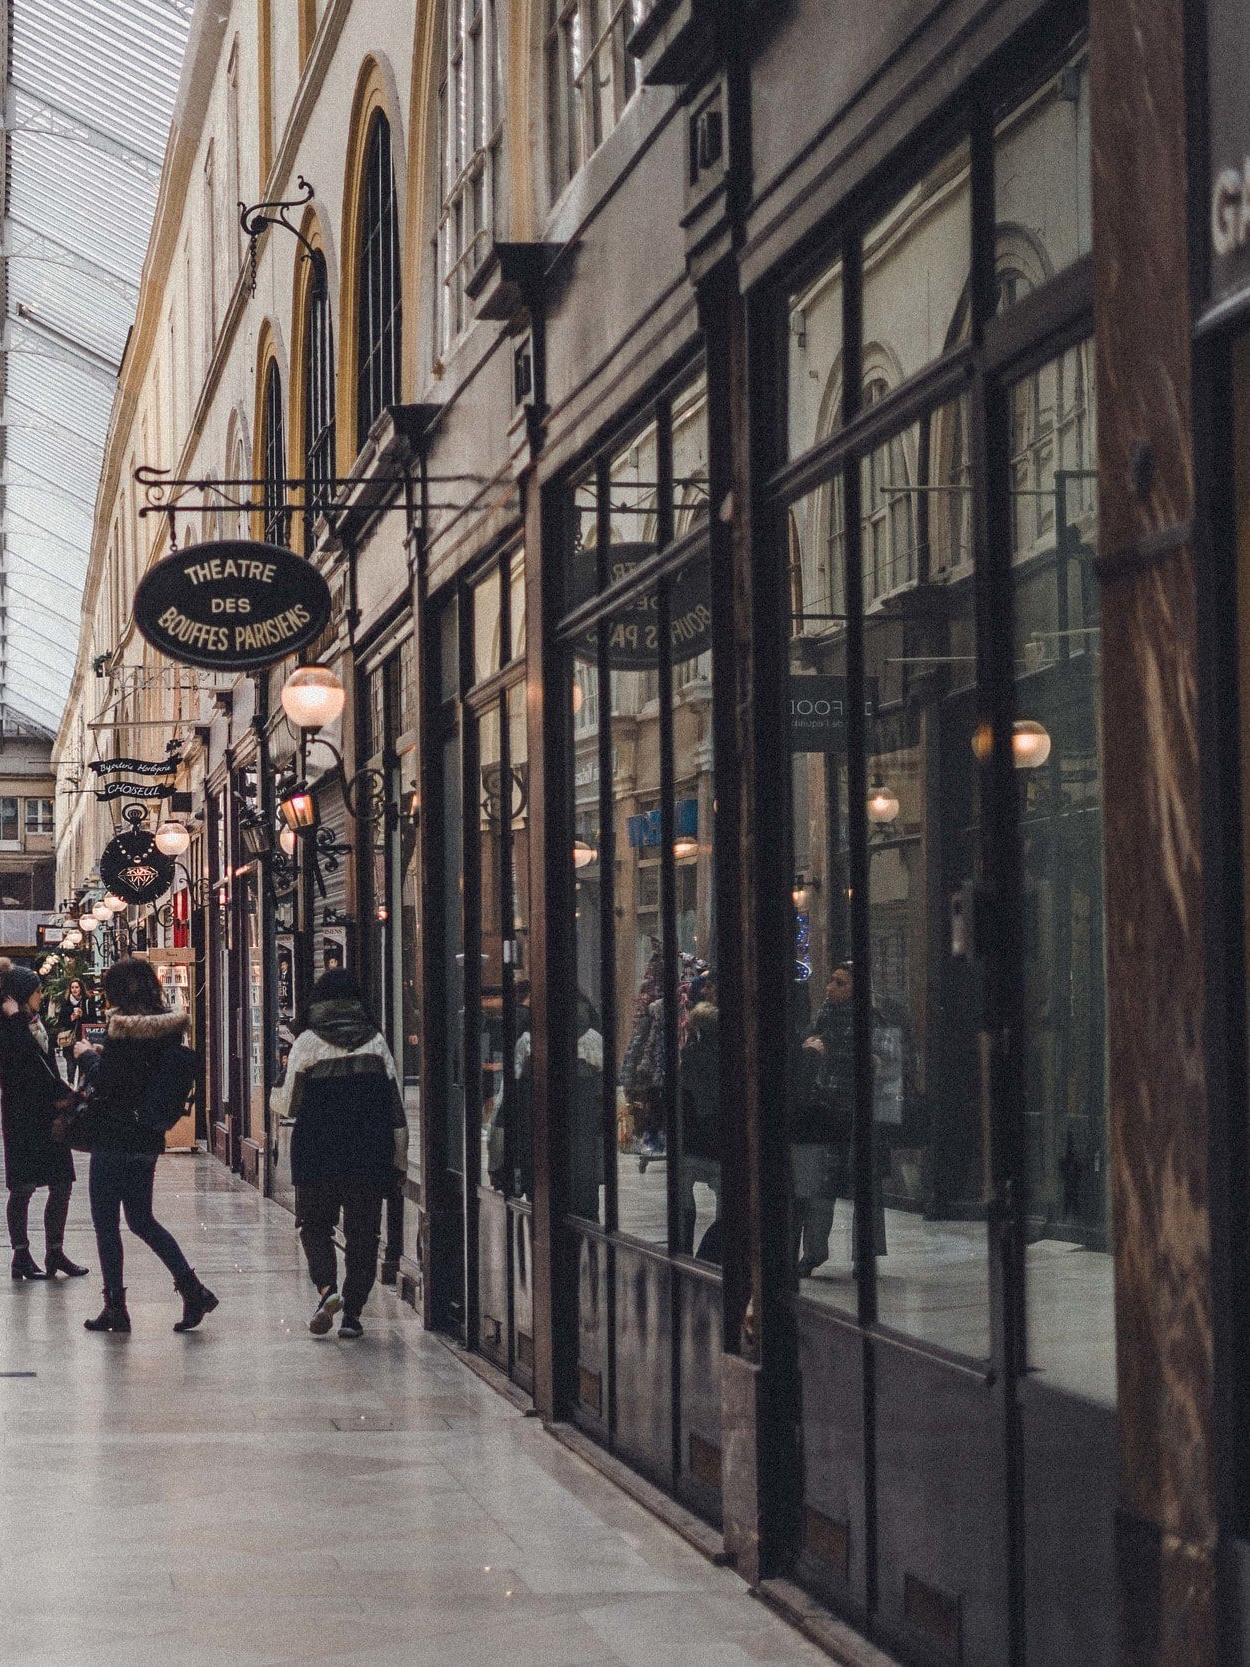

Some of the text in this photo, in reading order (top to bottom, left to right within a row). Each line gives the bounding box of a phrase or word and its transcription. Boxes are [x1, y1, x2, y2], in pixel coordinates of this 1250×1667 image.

[184, 558, 278, 585] THEATRE
[211, 598, 251, 614] DES
[157, 604, 311, 651] BOUFFES PARISIENS
[108, 784, 160, 796] CHOISEUL
